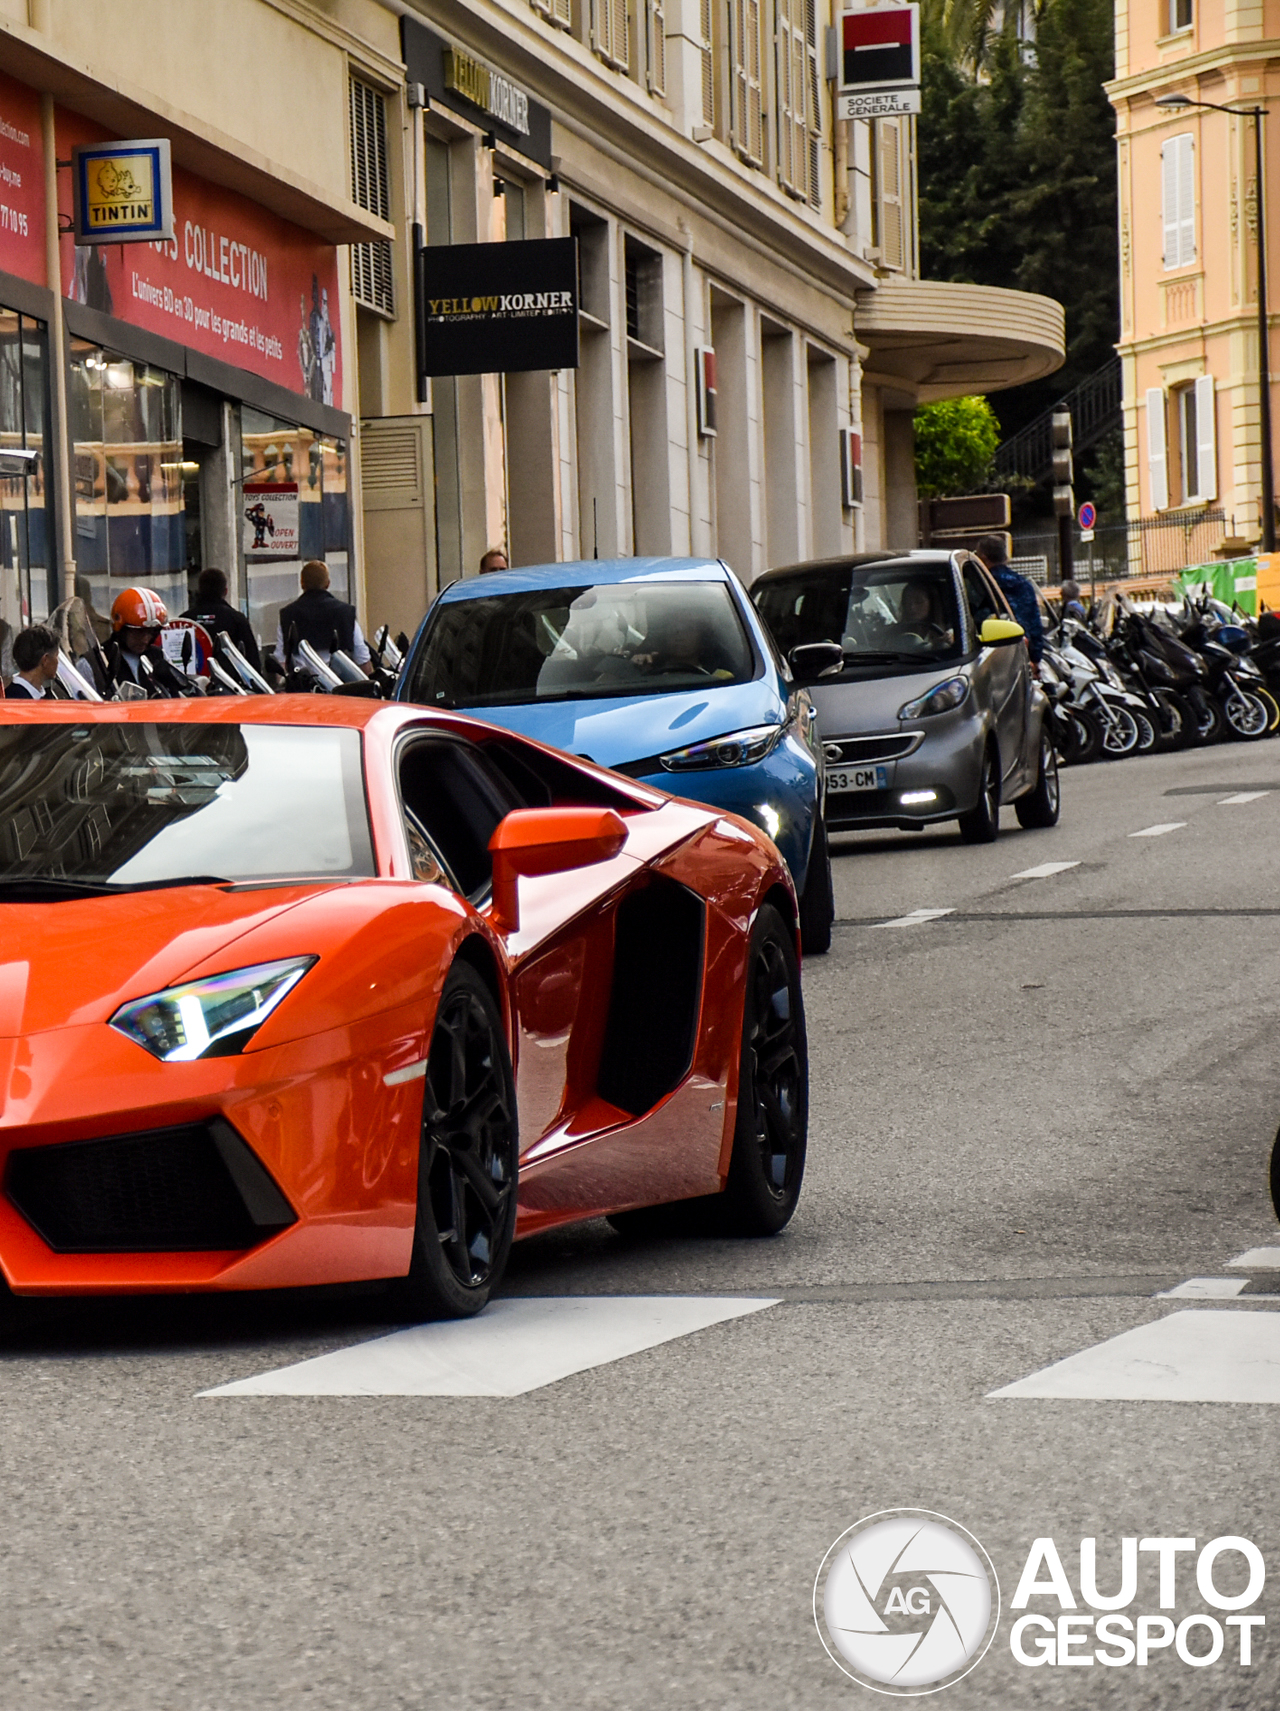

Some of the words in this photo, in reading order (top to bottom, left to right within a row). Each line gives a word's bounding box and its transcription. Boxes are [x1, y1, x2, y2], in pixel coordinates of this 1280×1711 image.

[847, 94, 898, 107] SOCIETE
[847, 102, 911, 116] GENERALE
[92, 204, 150, 221] TINTIN
[0, 204, 9, 229] 77
[10, 208, 18, 233] 10
[18, 212, 28, 237] 95
[184, 220, 268, 302] COLLECTION
[132, 271, 163, 309] L'univers
[163, 286, 174, 313] BD
[174, 298, 183, 318] en
[183, 296, 194, 322] 3D
[194, 306, 210, 330] pour
[210, 308, 221, 335] les
[222, 318, 248, 345] grands
[249, 326, 256, 347] et
[256, 326, 265, 352] les
[265, 335, 282, 360] petits
[245, 493, 260, 501] TOYS
[261, 493, 298, 501] COLLECTION
[275, 528, 295, 537] OPEN
[271, 541, 299, 550] OUVERT
[826, 771, 875, 789] 53-CM
